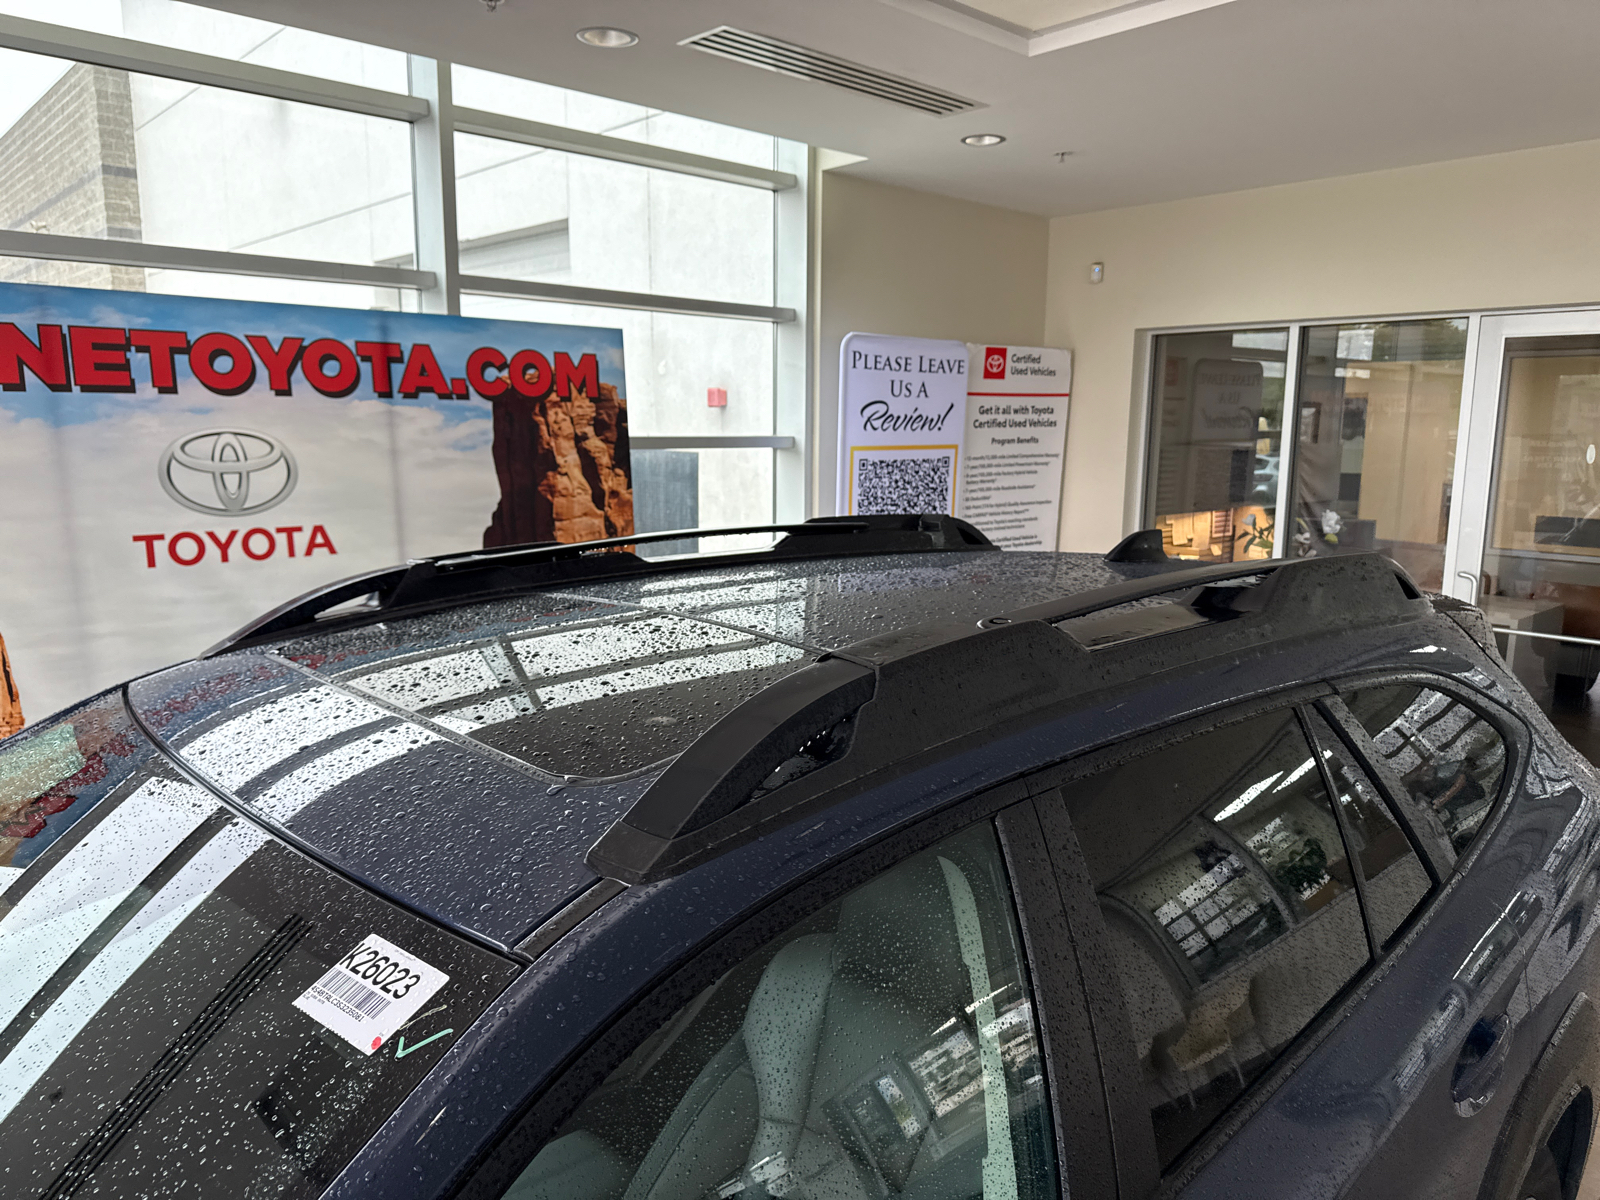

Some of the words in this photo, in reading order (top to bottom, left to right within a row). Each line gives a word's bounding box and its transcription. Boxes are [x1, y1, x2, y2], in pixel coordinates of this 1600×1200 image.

[0, 322, 598, 400] NETOYOTA.COM
[852, 350, 912, 373] PLEASE
[918, 355, 965, 375] LEAVE
[1011, 354, 1041, 364] Certified
[1011, 366, 1028, 376] Used
[1030, 367, 1057, 377] Vehicles
[890, 379, 912, 398] US
[917, 381, 929, 398] A
[860, 400, 954, 432] Review!
[978, 405, 993, 415] Get
[994, 405, 1001, 415] it
[1001, 405, 1011, 415] all
[1013, 405, 1029, 415] with
[1031, 405, 1054, 417] Toyota
[973, 418, 1007, 429] Certified
[1008, 418, 1027, 428] Used
[1029, 417, 1057, 428] Vehicles
[991, 437, 1015, 447] Program
[1017, 436, 1039, 444] Benefits
[133, 525, 337, 568] TOYOTA
[339, 943, 421, 999] K26023
